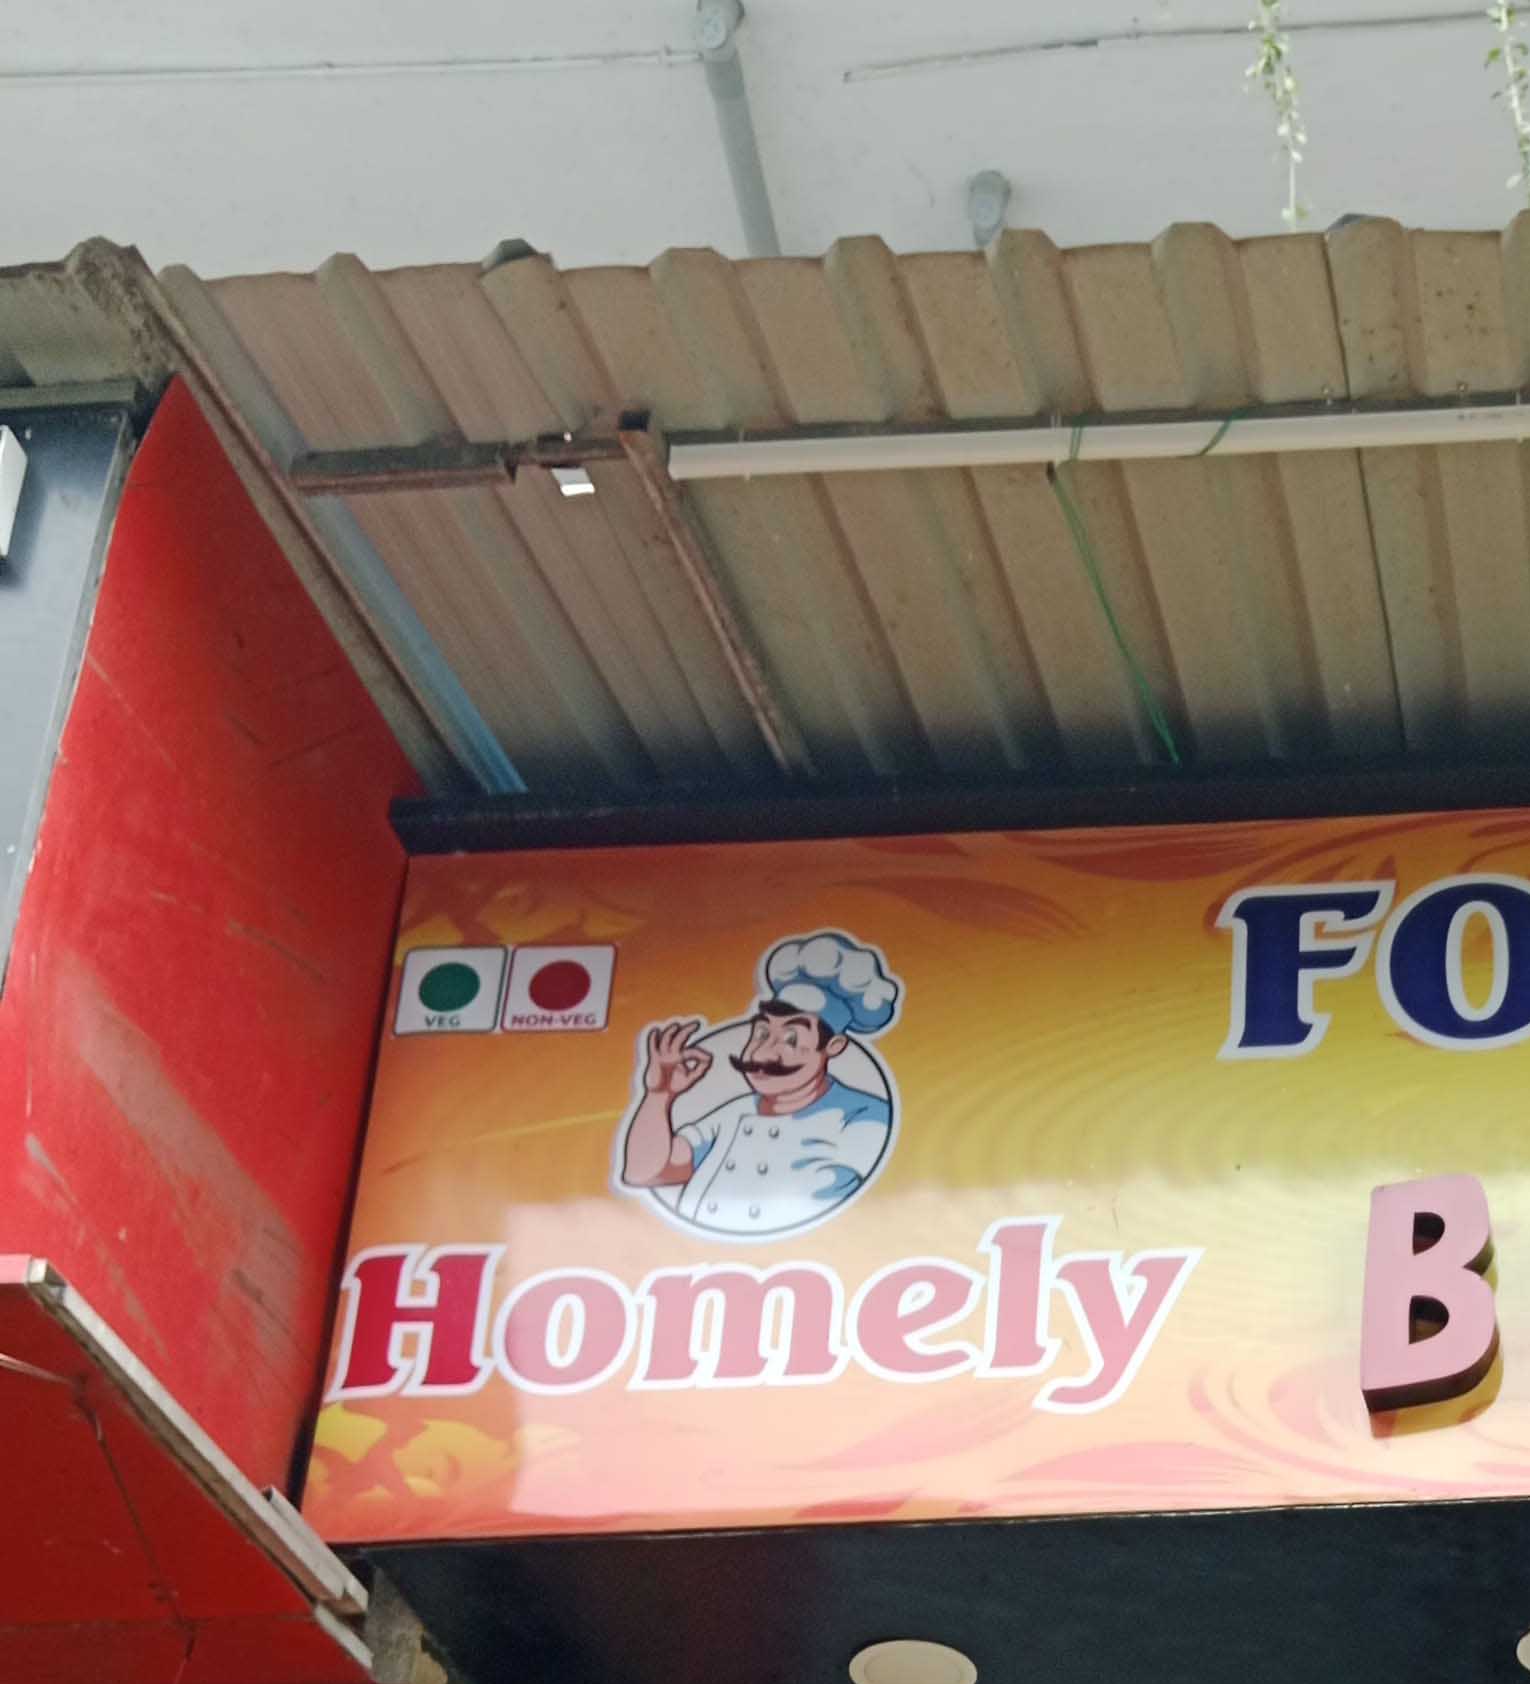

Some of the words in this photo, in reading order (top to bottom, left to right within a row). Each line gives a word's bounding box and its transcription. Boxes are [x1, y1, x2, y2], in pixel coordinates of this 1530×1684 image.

[424, 1014, 461, 1027] VEG
[511, 1012, 598, 1026] NON-VEG
[328, 1220, 1198, 1410] Homely
